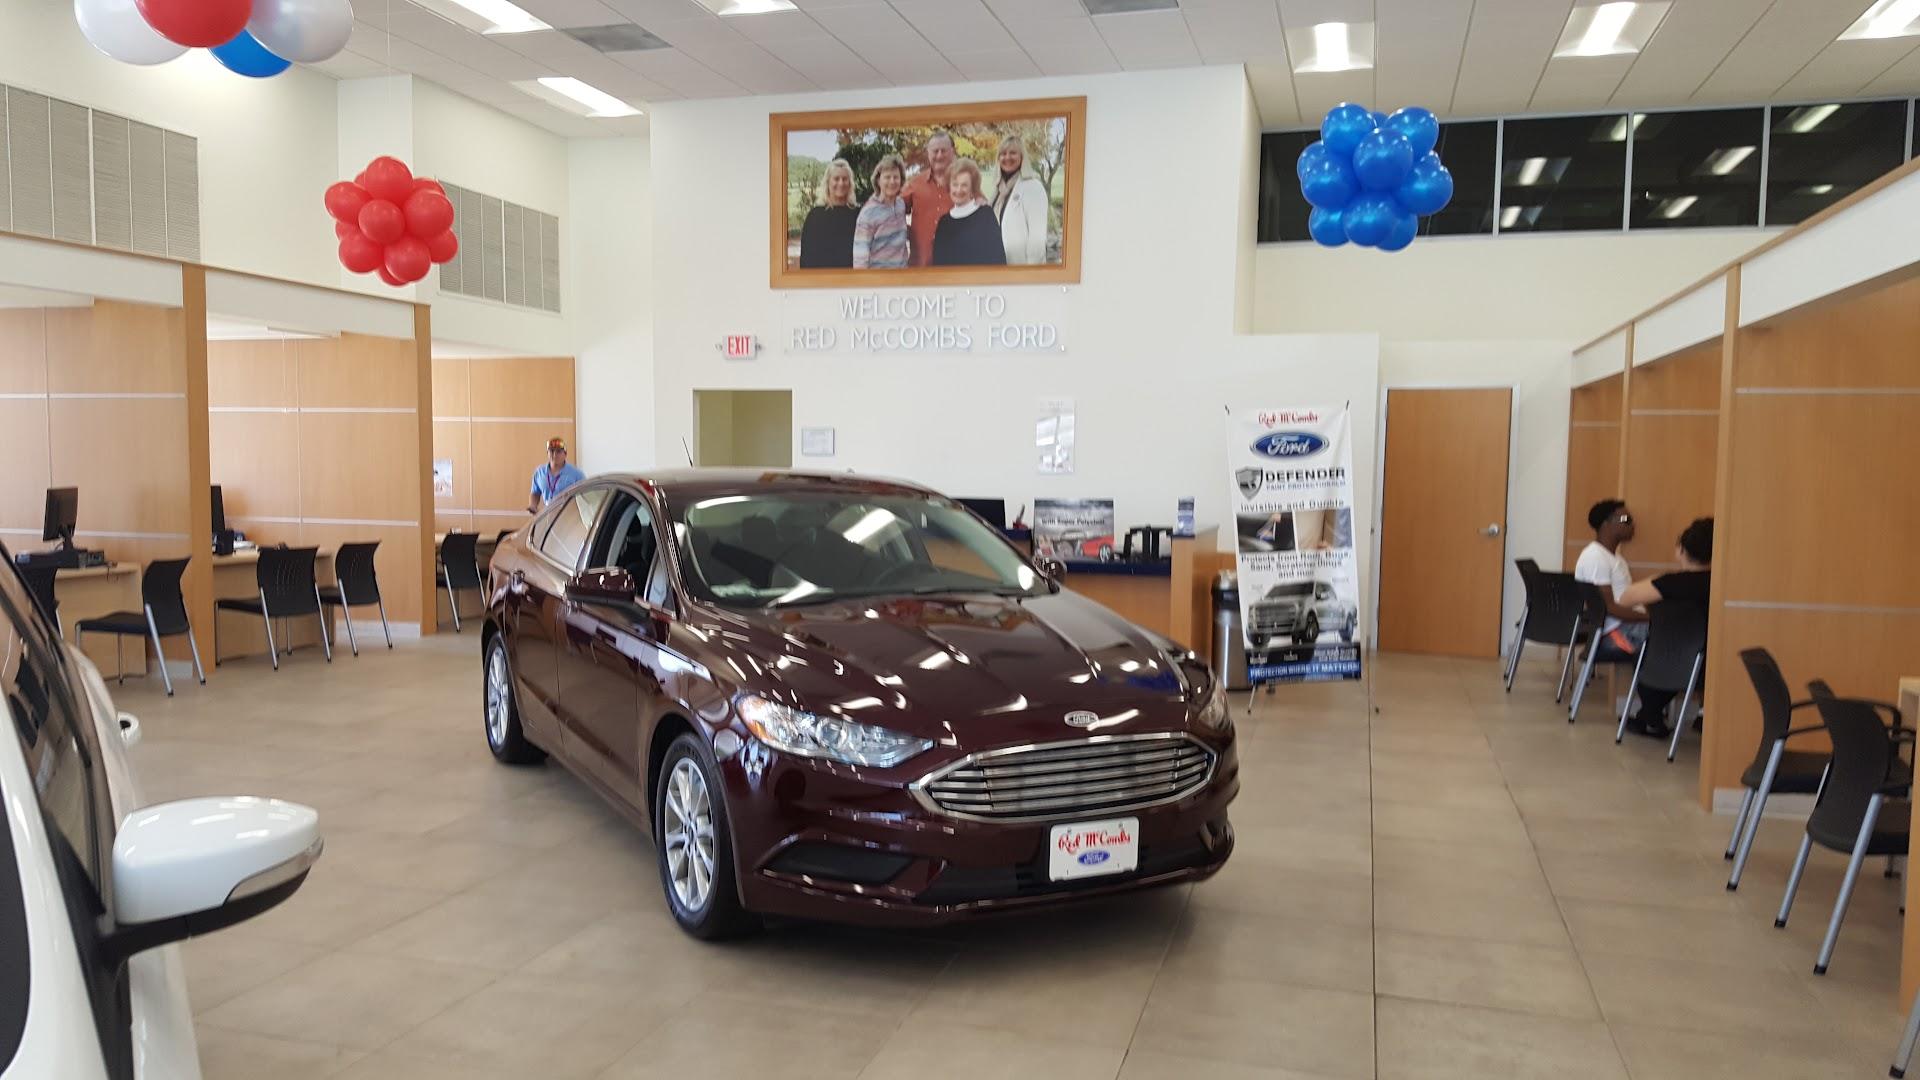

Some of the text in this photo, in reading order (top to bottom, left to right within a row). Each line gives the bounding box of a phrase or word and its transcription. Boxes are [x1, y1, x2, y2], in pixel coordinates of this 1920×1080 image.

[839, 293, 1005, 321] WELCOME TO
[727, 335, 751, 355] EXIT
[791, 323, 1057, 351] RED McCOMBS FORD
[1267, 434, 1311, 456] Ford
[1265, 467, 1345, 483] DEFENDER
[1240, 502, 1283, 512] Invisible
[1287, 501, 1305, 510] and
[1058, 833, 1081, 854] Red
